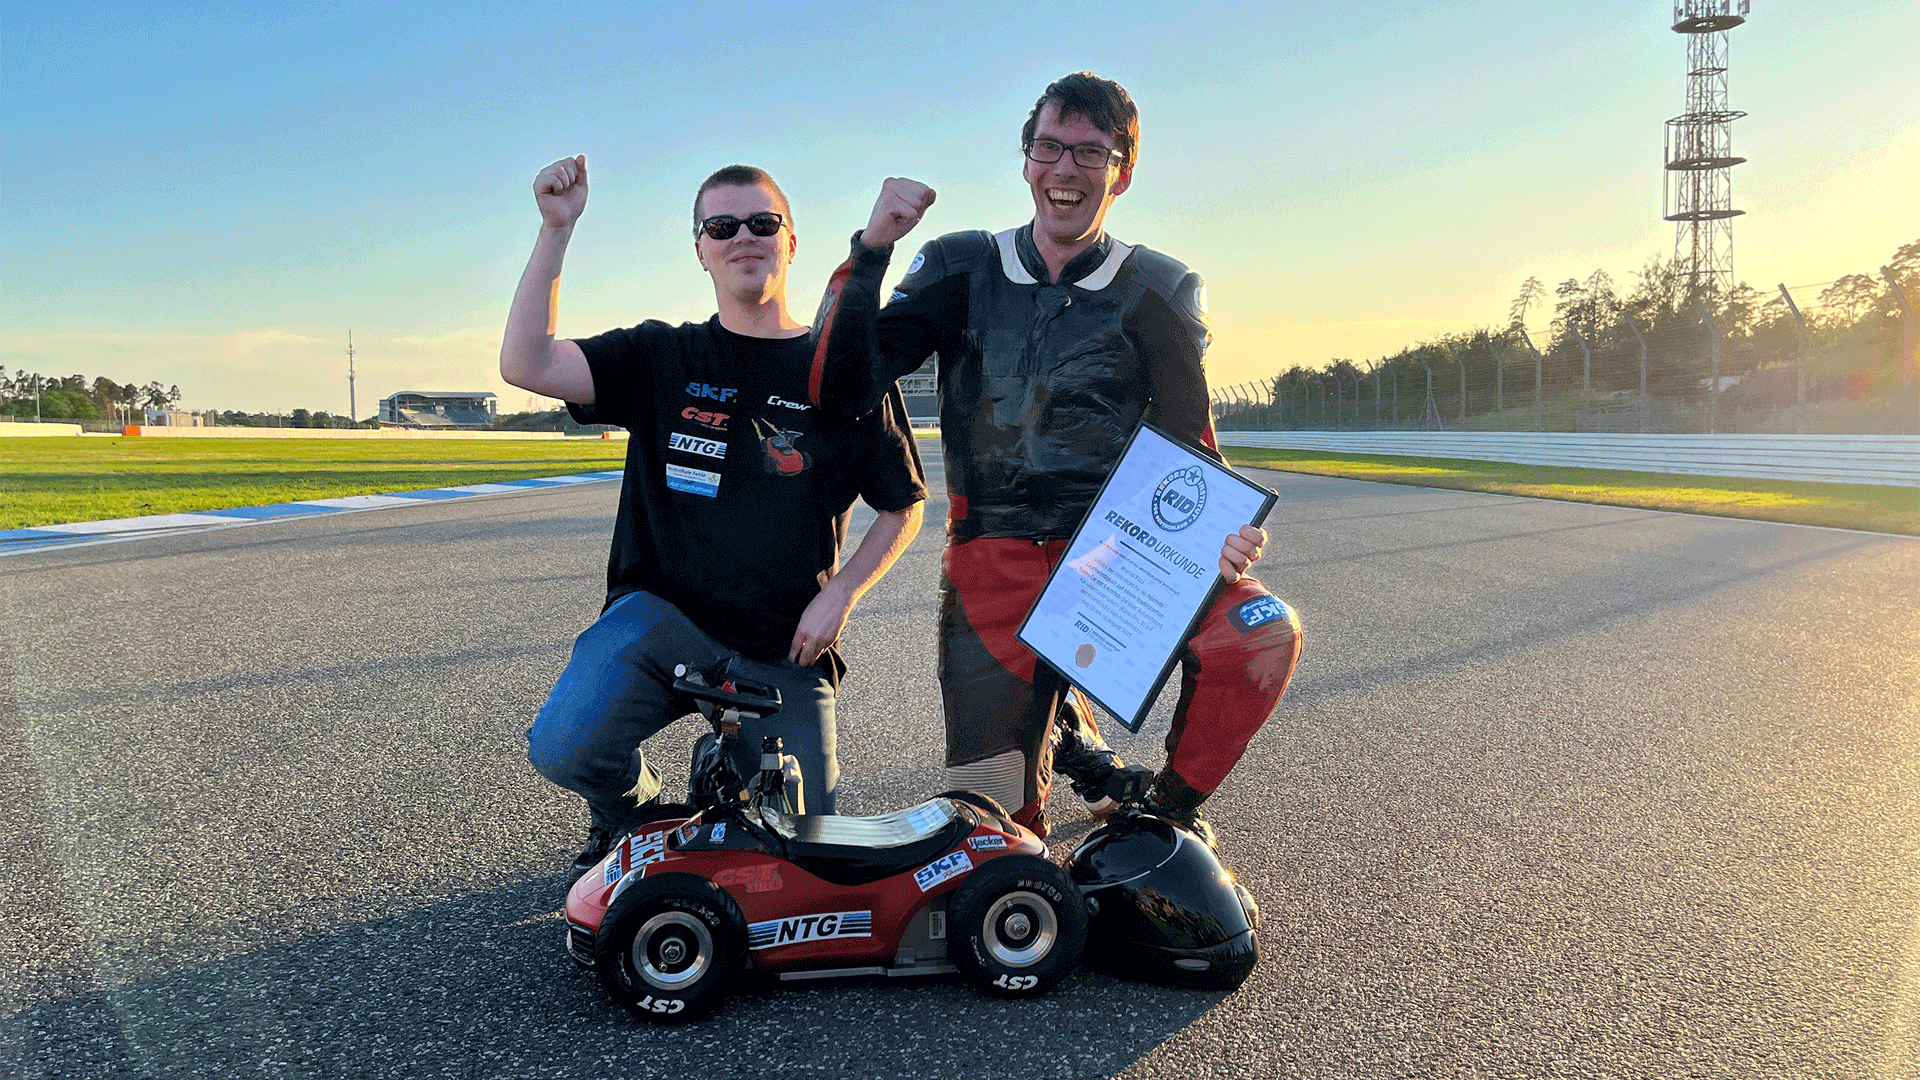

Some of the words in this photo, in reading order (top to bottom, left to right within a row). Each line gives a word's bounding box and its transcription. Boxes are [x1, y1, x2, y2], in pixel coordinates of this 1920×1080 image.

[685, 382, 738, 402] SKF
[767, 395, 811, 410] Crew
[682, 407, 731, 426] CST
[677, 437, 718, 454] NTG
[1162, 489, 1195, 514] RID
[1104, 508, 1205, 580] REKORDURKUNDE
[1074, 618, 1089, 633] RID
[630, 830, 665, 869] SKF
[968, 836, 1003, 850] Hacker
[917, 851, 964, 885] SKF
[777, 914, 839, 943] NTG
[993, 973, 1038, 990] CST
[636, 995, 685, 1014] CST
